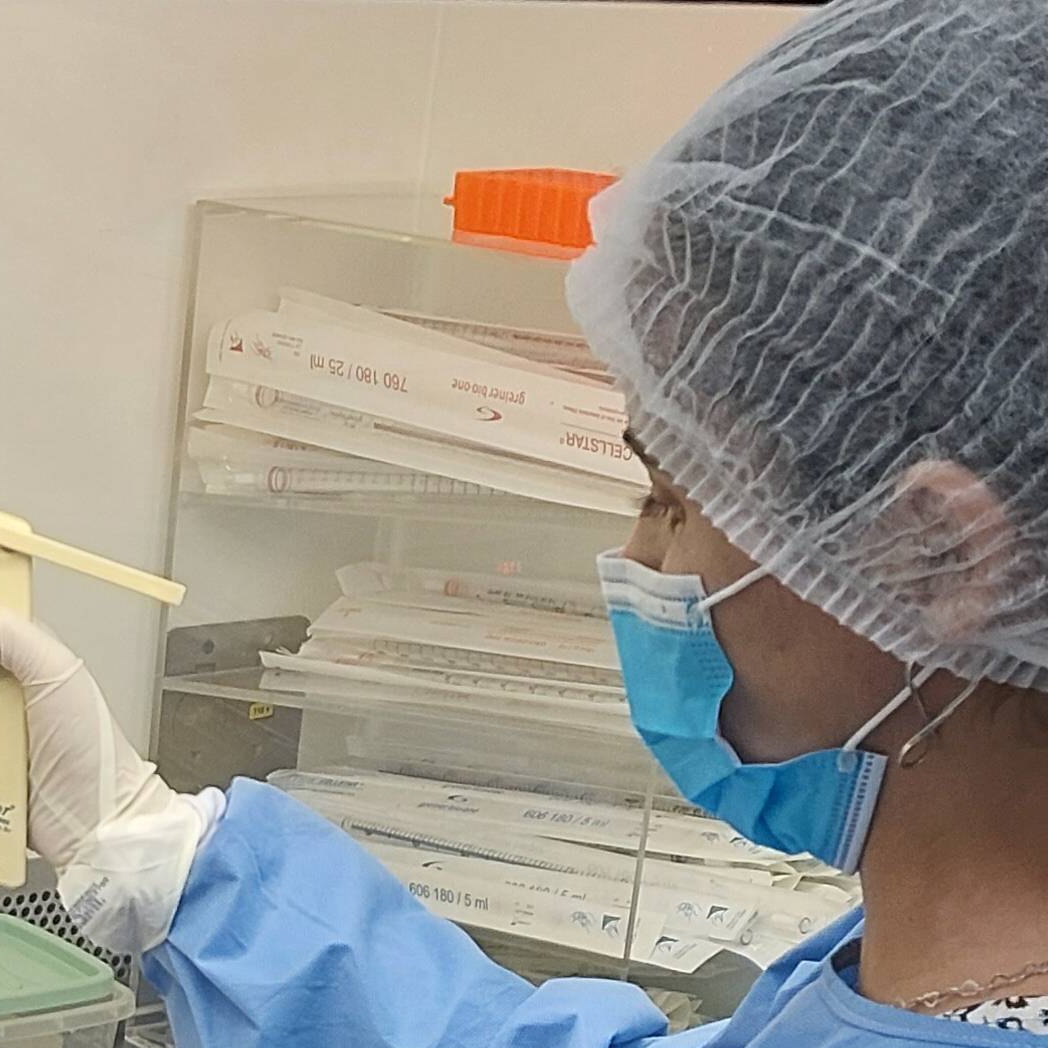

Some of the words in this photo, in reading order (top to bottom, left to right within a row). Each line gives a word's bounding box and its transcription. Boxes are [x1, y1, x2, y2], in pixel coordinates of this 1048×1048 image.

[310, 354, 325, 369] ml
[328, 358, 345, 377] 25
[347, 363, 353, 379] /
[356, 365, 378, 386] 180
[383, 372, 409, 393] 760
[489, 386, 527, 405] greiner
[409, 882, 430, 899] 606
[433, 887, 454, 903] 180
[456, 891, 462, 905] /
[464, 893, 472, 907] 5
[474, 897, 489, 911] ml
